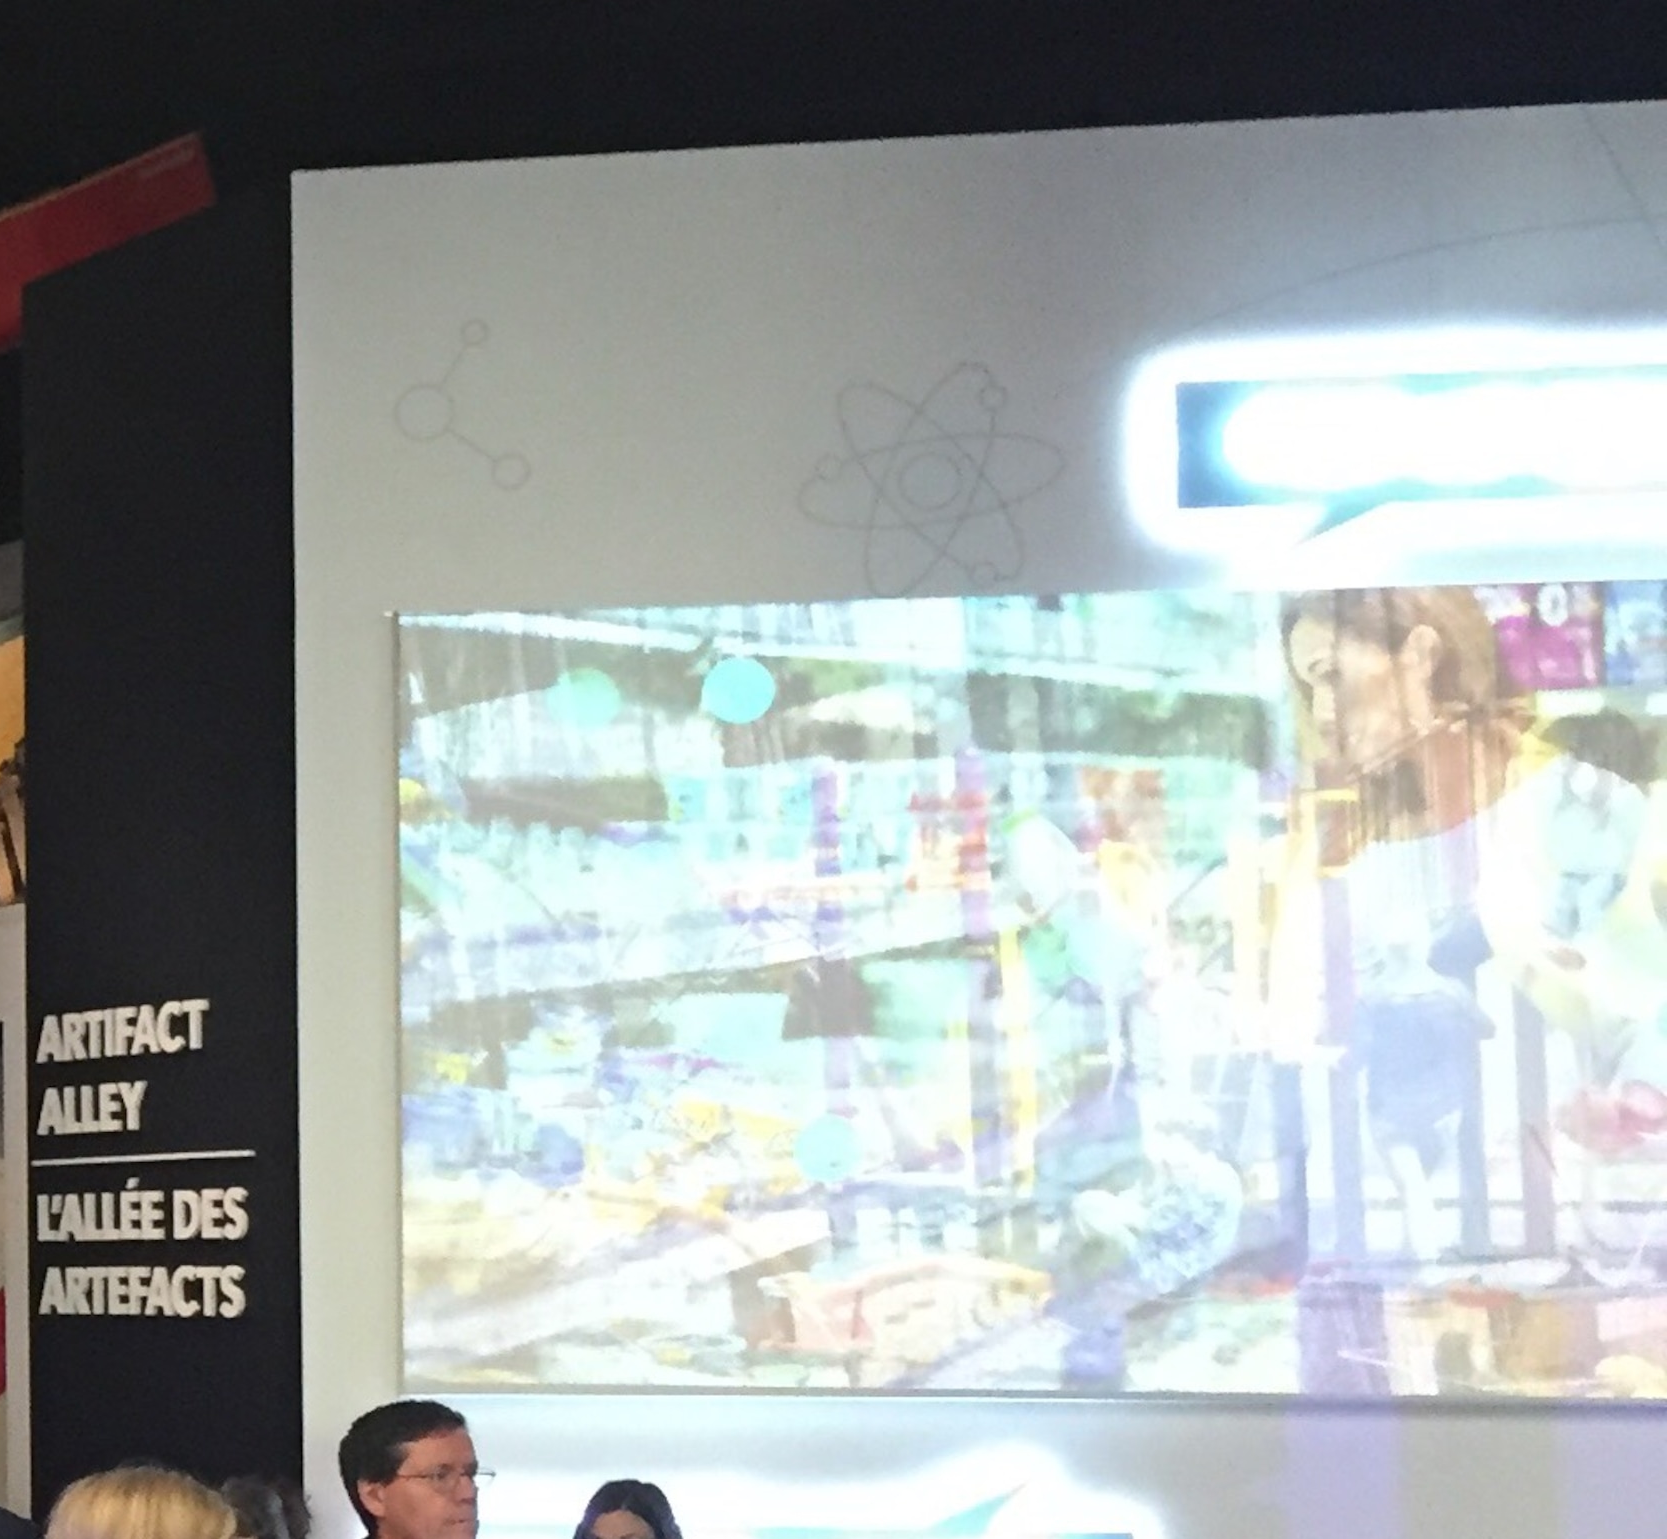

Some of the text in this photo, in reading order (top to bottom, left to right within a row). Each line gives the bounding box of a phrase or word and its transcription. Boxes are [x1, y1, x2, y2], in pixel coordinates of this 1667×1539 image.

[35, 999, 210, 1064] ARTIFACT
[36, 1080, 148, 1136] ALLEY
[36, 1177, 250, 1242] L'ALLÉE DES
[38, 1264, 247, 1319] ARTEFACTS
